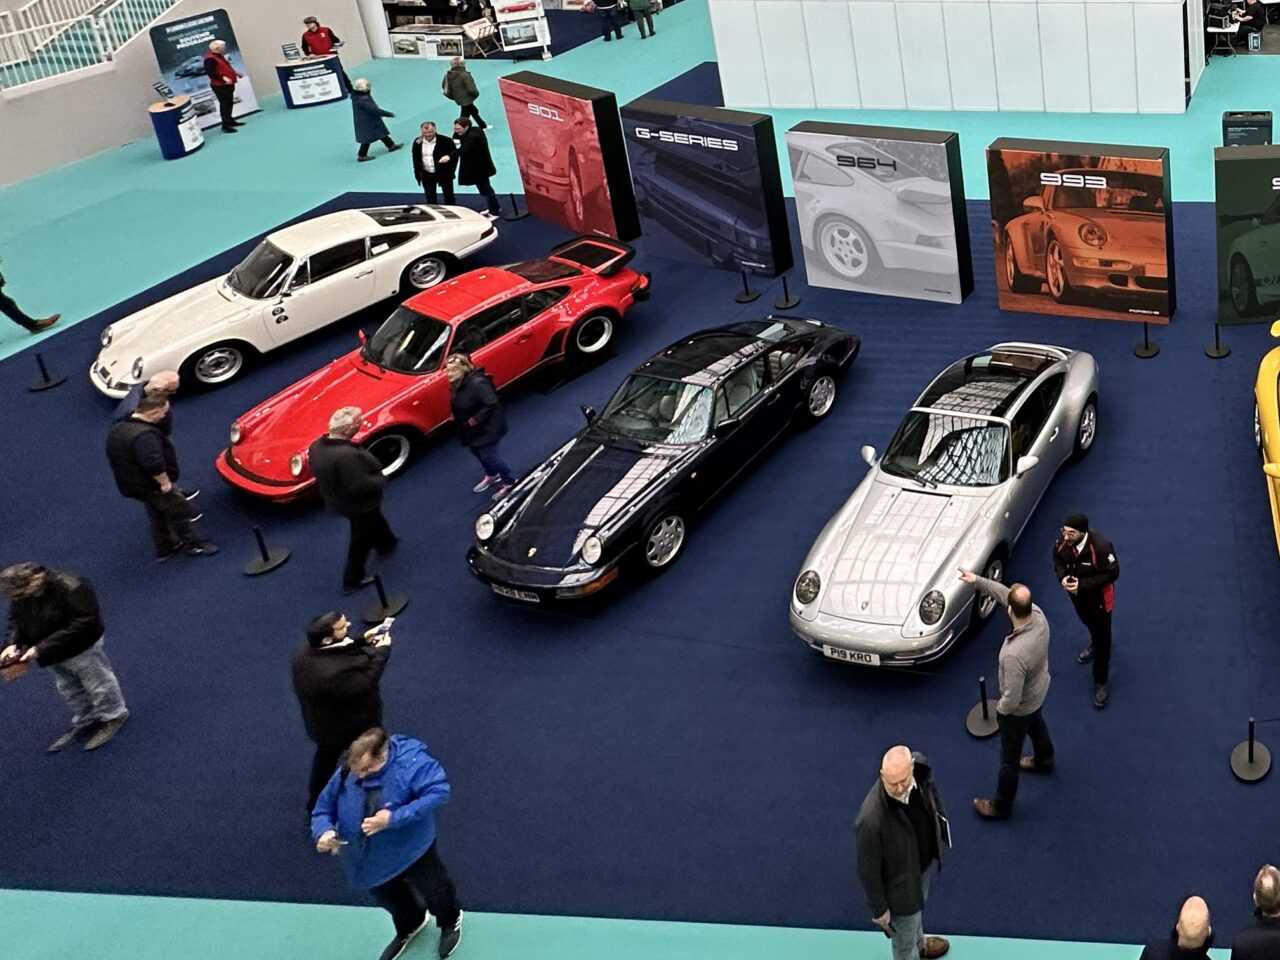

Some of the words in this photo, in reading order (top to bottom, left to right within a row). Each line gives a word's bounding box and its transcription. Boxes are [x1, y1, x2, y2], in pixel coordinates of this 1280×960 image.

[528, 103, 564, 122] 901
[635, 127, 739, 151] G-SERIES
[836, 155, 897, 171] 964
[1040, 172, 1107, 189] 993
